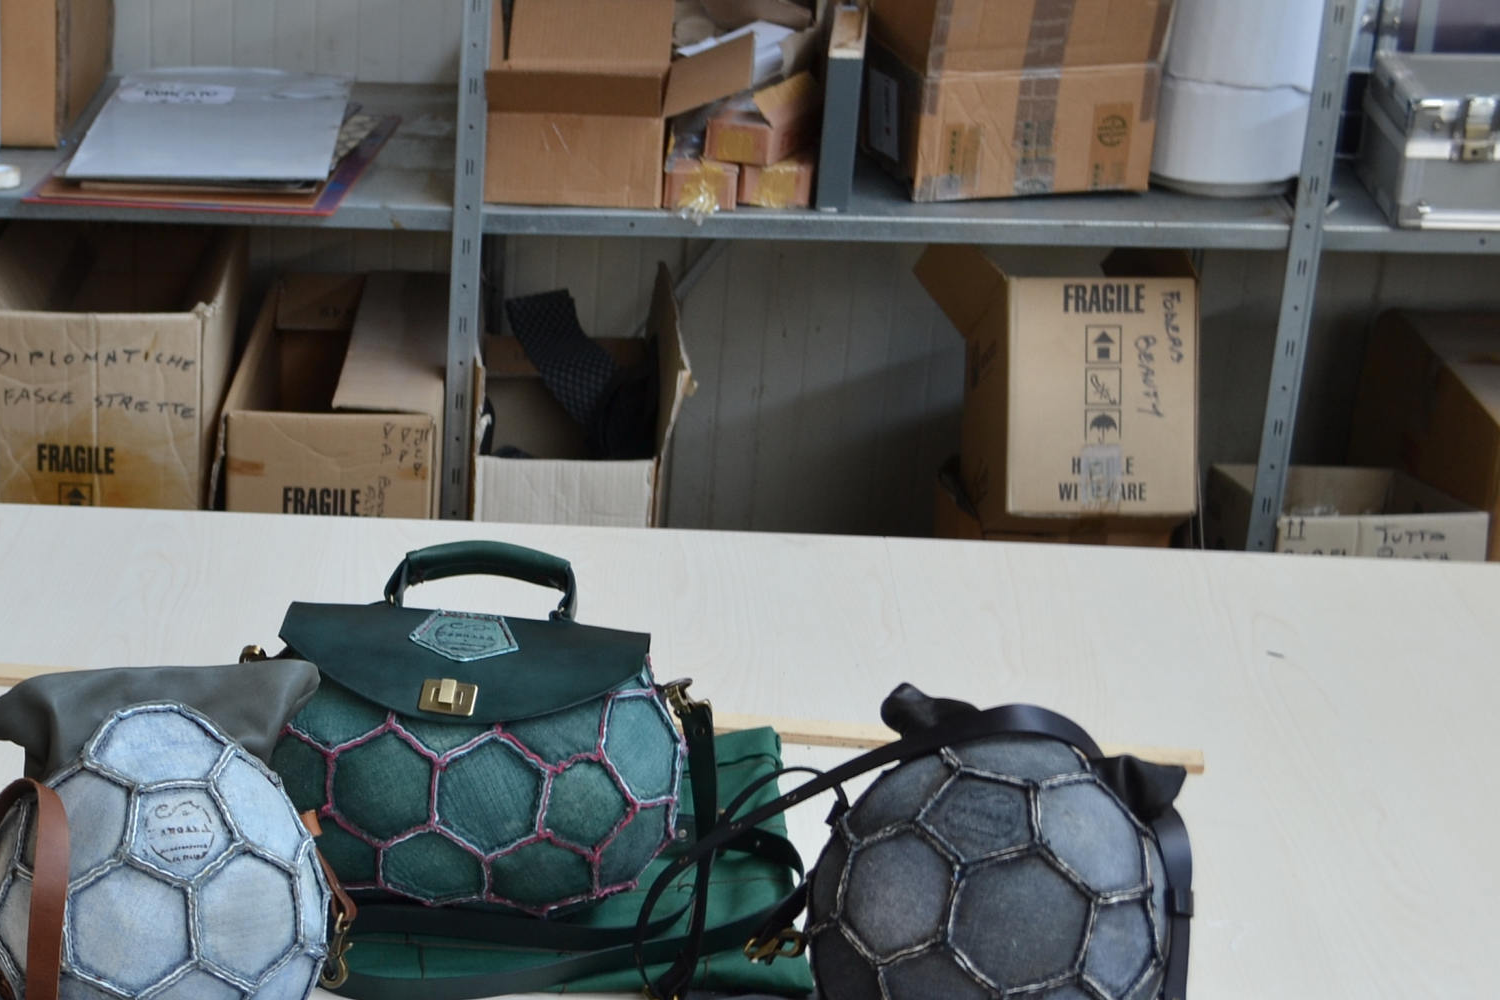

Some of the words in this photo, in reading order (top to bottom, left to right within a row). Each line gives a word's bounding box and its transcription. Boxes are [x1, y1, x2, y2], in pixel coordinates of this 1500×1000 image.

[1063, 284, 1145, 313] FRAGILE
[37, 443, 115, 475] FRAGILE
[282, 486, 362, 516] FRAGILE
